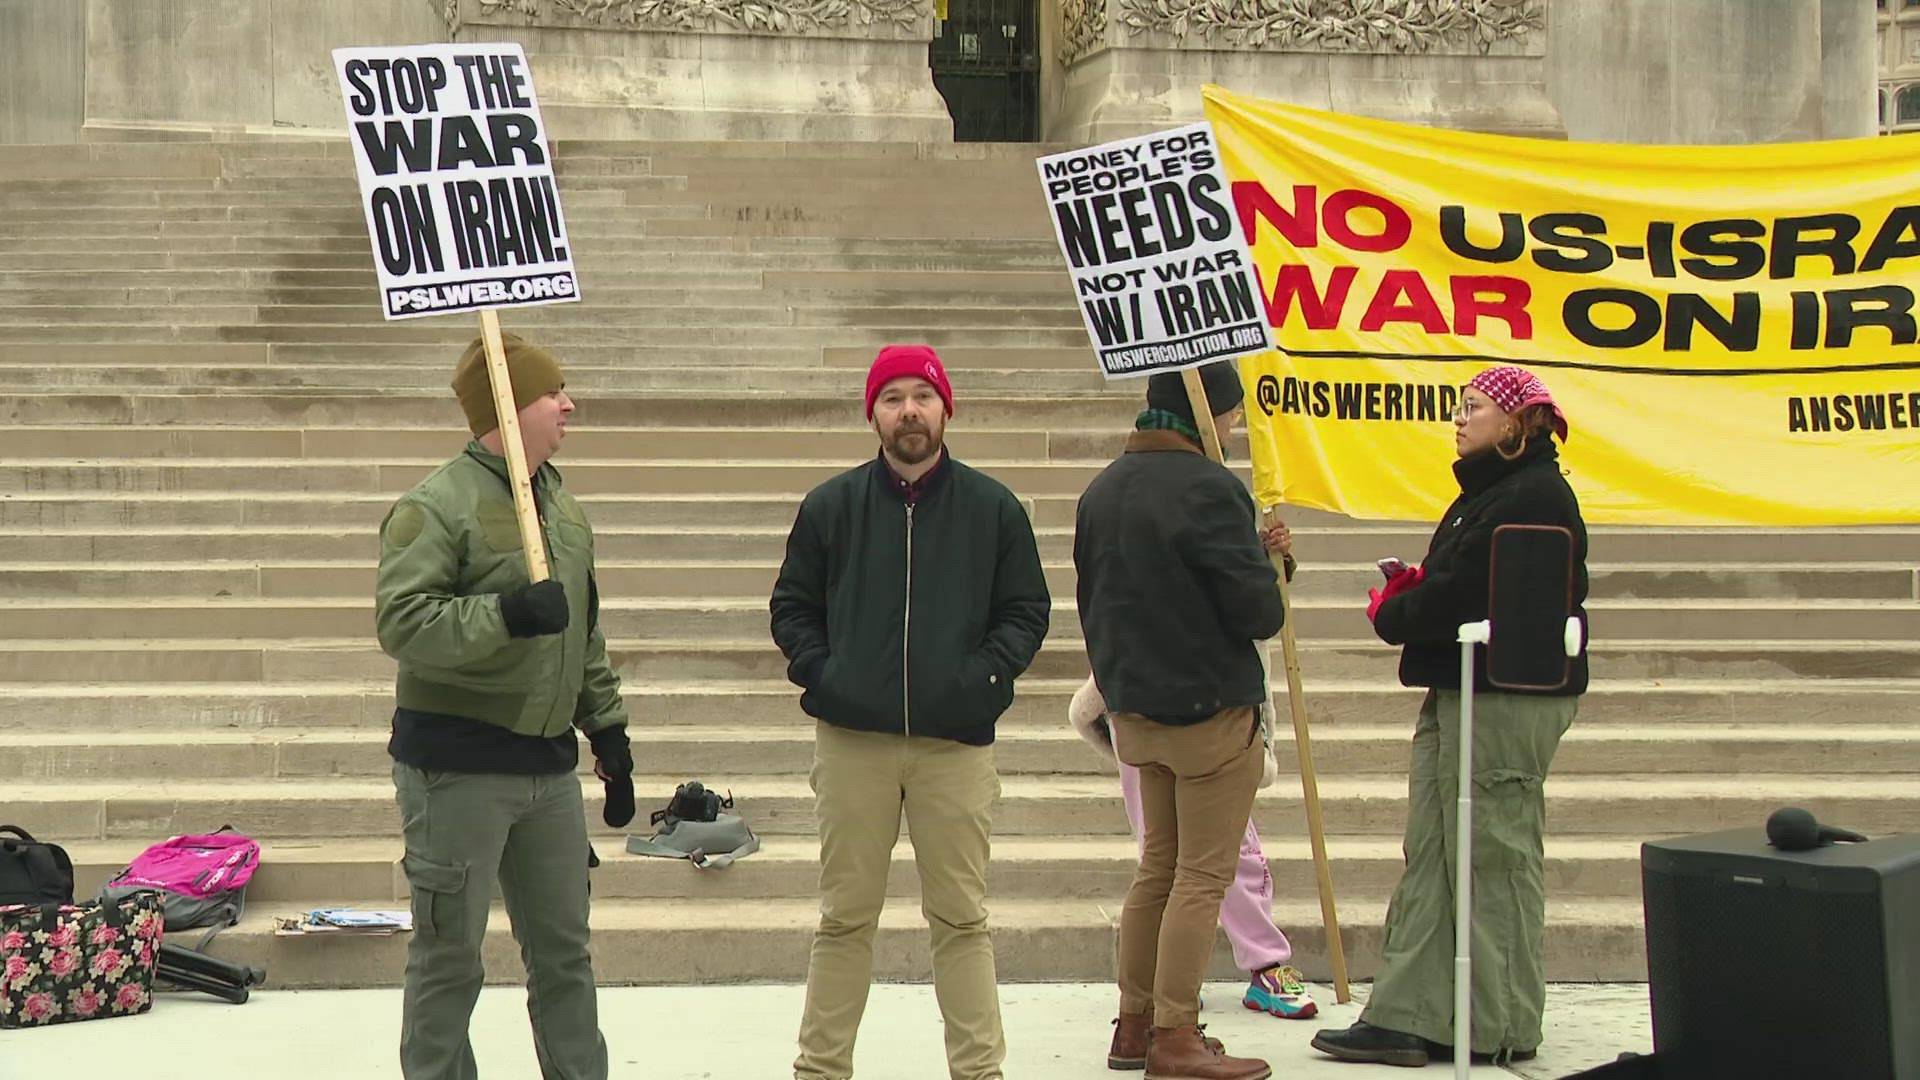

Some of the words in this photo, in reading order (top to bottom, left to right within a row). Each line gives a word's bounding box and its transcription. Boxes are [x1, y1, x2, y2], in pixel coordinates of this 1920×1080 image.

[345, 57, 447, 116] STOP
[453, 55, 532, 110] THE
[354, 113, 545, 176] WAR
[1044, 145, 1142, 179] MONEY
[1149, 131, 1210, 158] FOR
[1048, 150, 1216, 200] PEOPLE'S
[371, 183, 445, 277] ON
[443, 175, 568, 270] IRAN!
[1055, 173, 1232, 268] NEEDS
[1231, 181, 1412, 253] NO
[390, 275, 574, 312] PSLWEB.ORG
[1077, 269, 1146, 296] NOT
[1153, 249, 1242, 283] WAR
[1084, 293, 1145, 347] W/
[1154, 271, 1258, 338] IRAN
[1252, 264, 1533, 340] WAR
[1562, 287, 1761, 352] ON
[1790, 285, 1920, 350] IR
[1105, 326, 1264, 371] ANSWERCOALITION.ORG
[1256, 375, 1464, 422] @ANSWERIND
